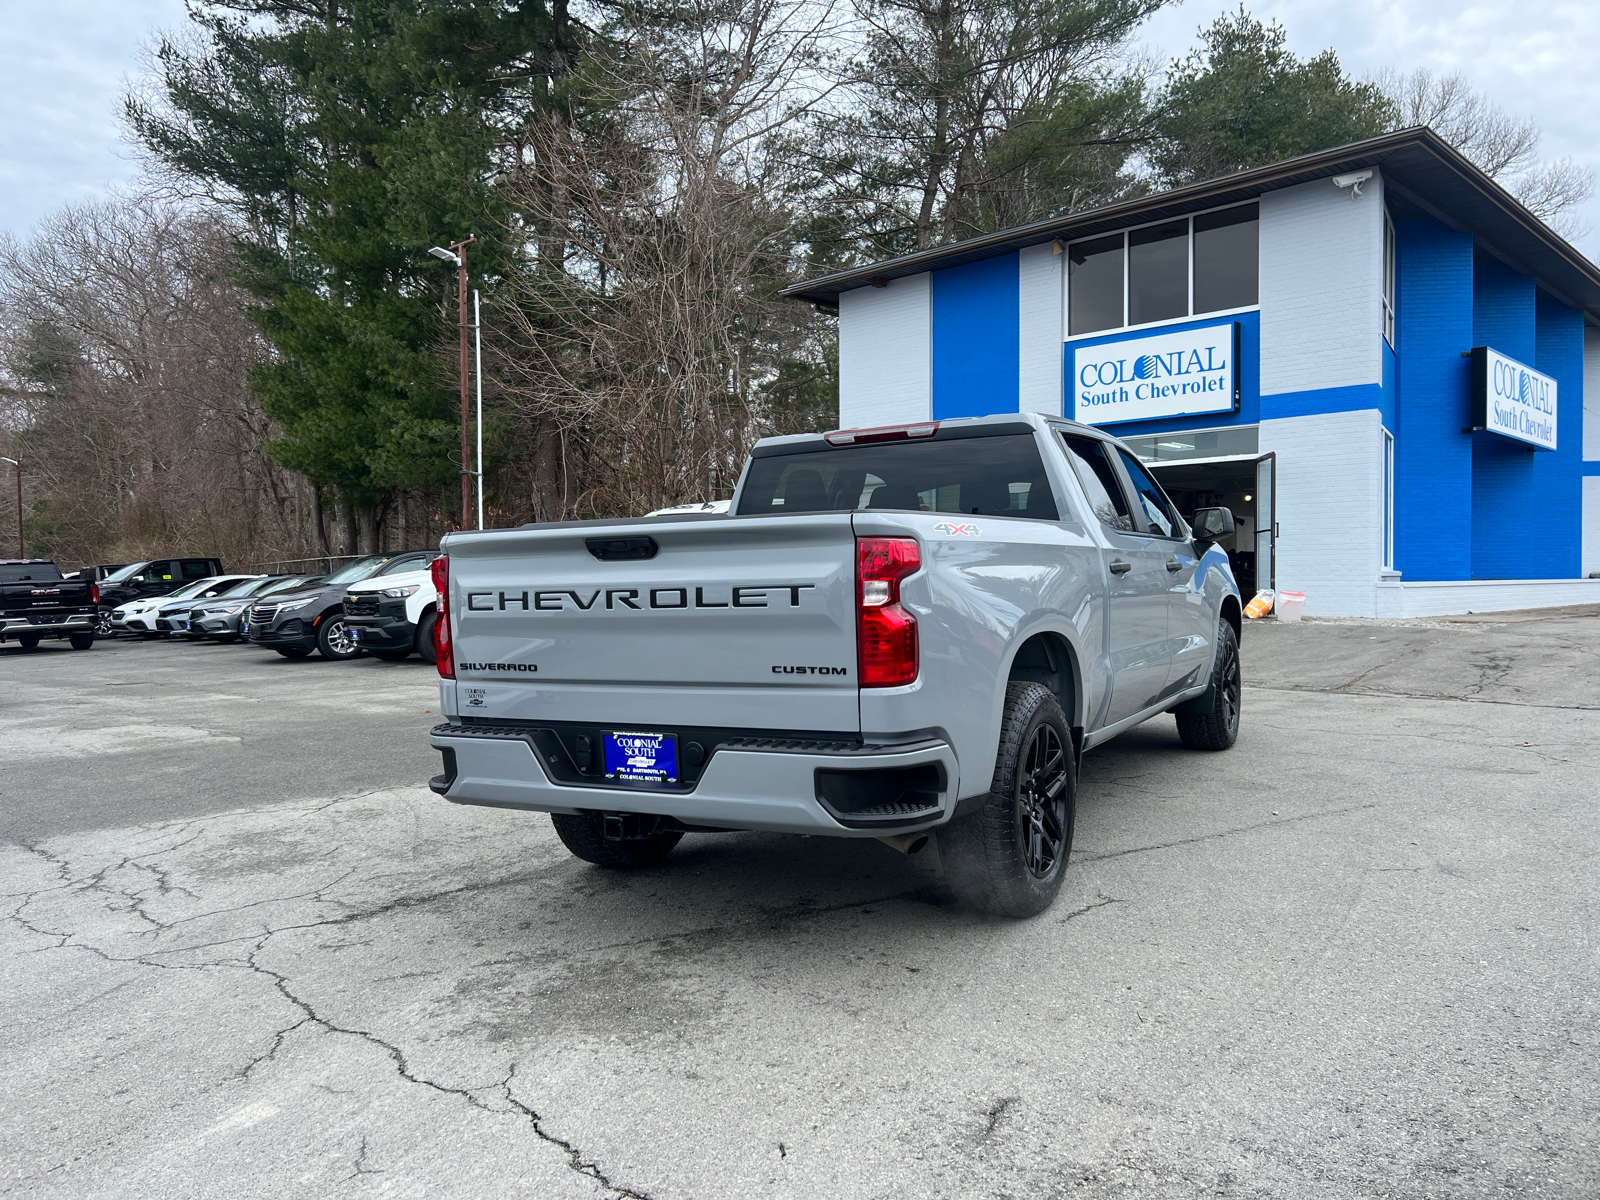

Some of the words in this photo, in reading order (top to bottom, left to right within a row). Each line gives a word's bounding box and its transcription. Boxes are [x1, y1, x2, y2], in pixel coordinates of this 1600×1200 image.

[1080, 346, 1226, 388] COLONIAL
[1081, 386, 1129, 407] South
[1135, 375, 1226, 400] Chevrolet
[1494, 359, 1553, 416] COLONIAL
[1494, 400, 1518, 431] South
[1520, 410, 1553, 442] Chevrolet
[467, 584, 816, 612] CHEVROLET
[460, 662, 538, 672] SILVERADO
[771, 665, 847, 675] CUSTOM
[617, 738, 662, 748] COLONIAL
[625, 748, 655, 756] SOUTH
